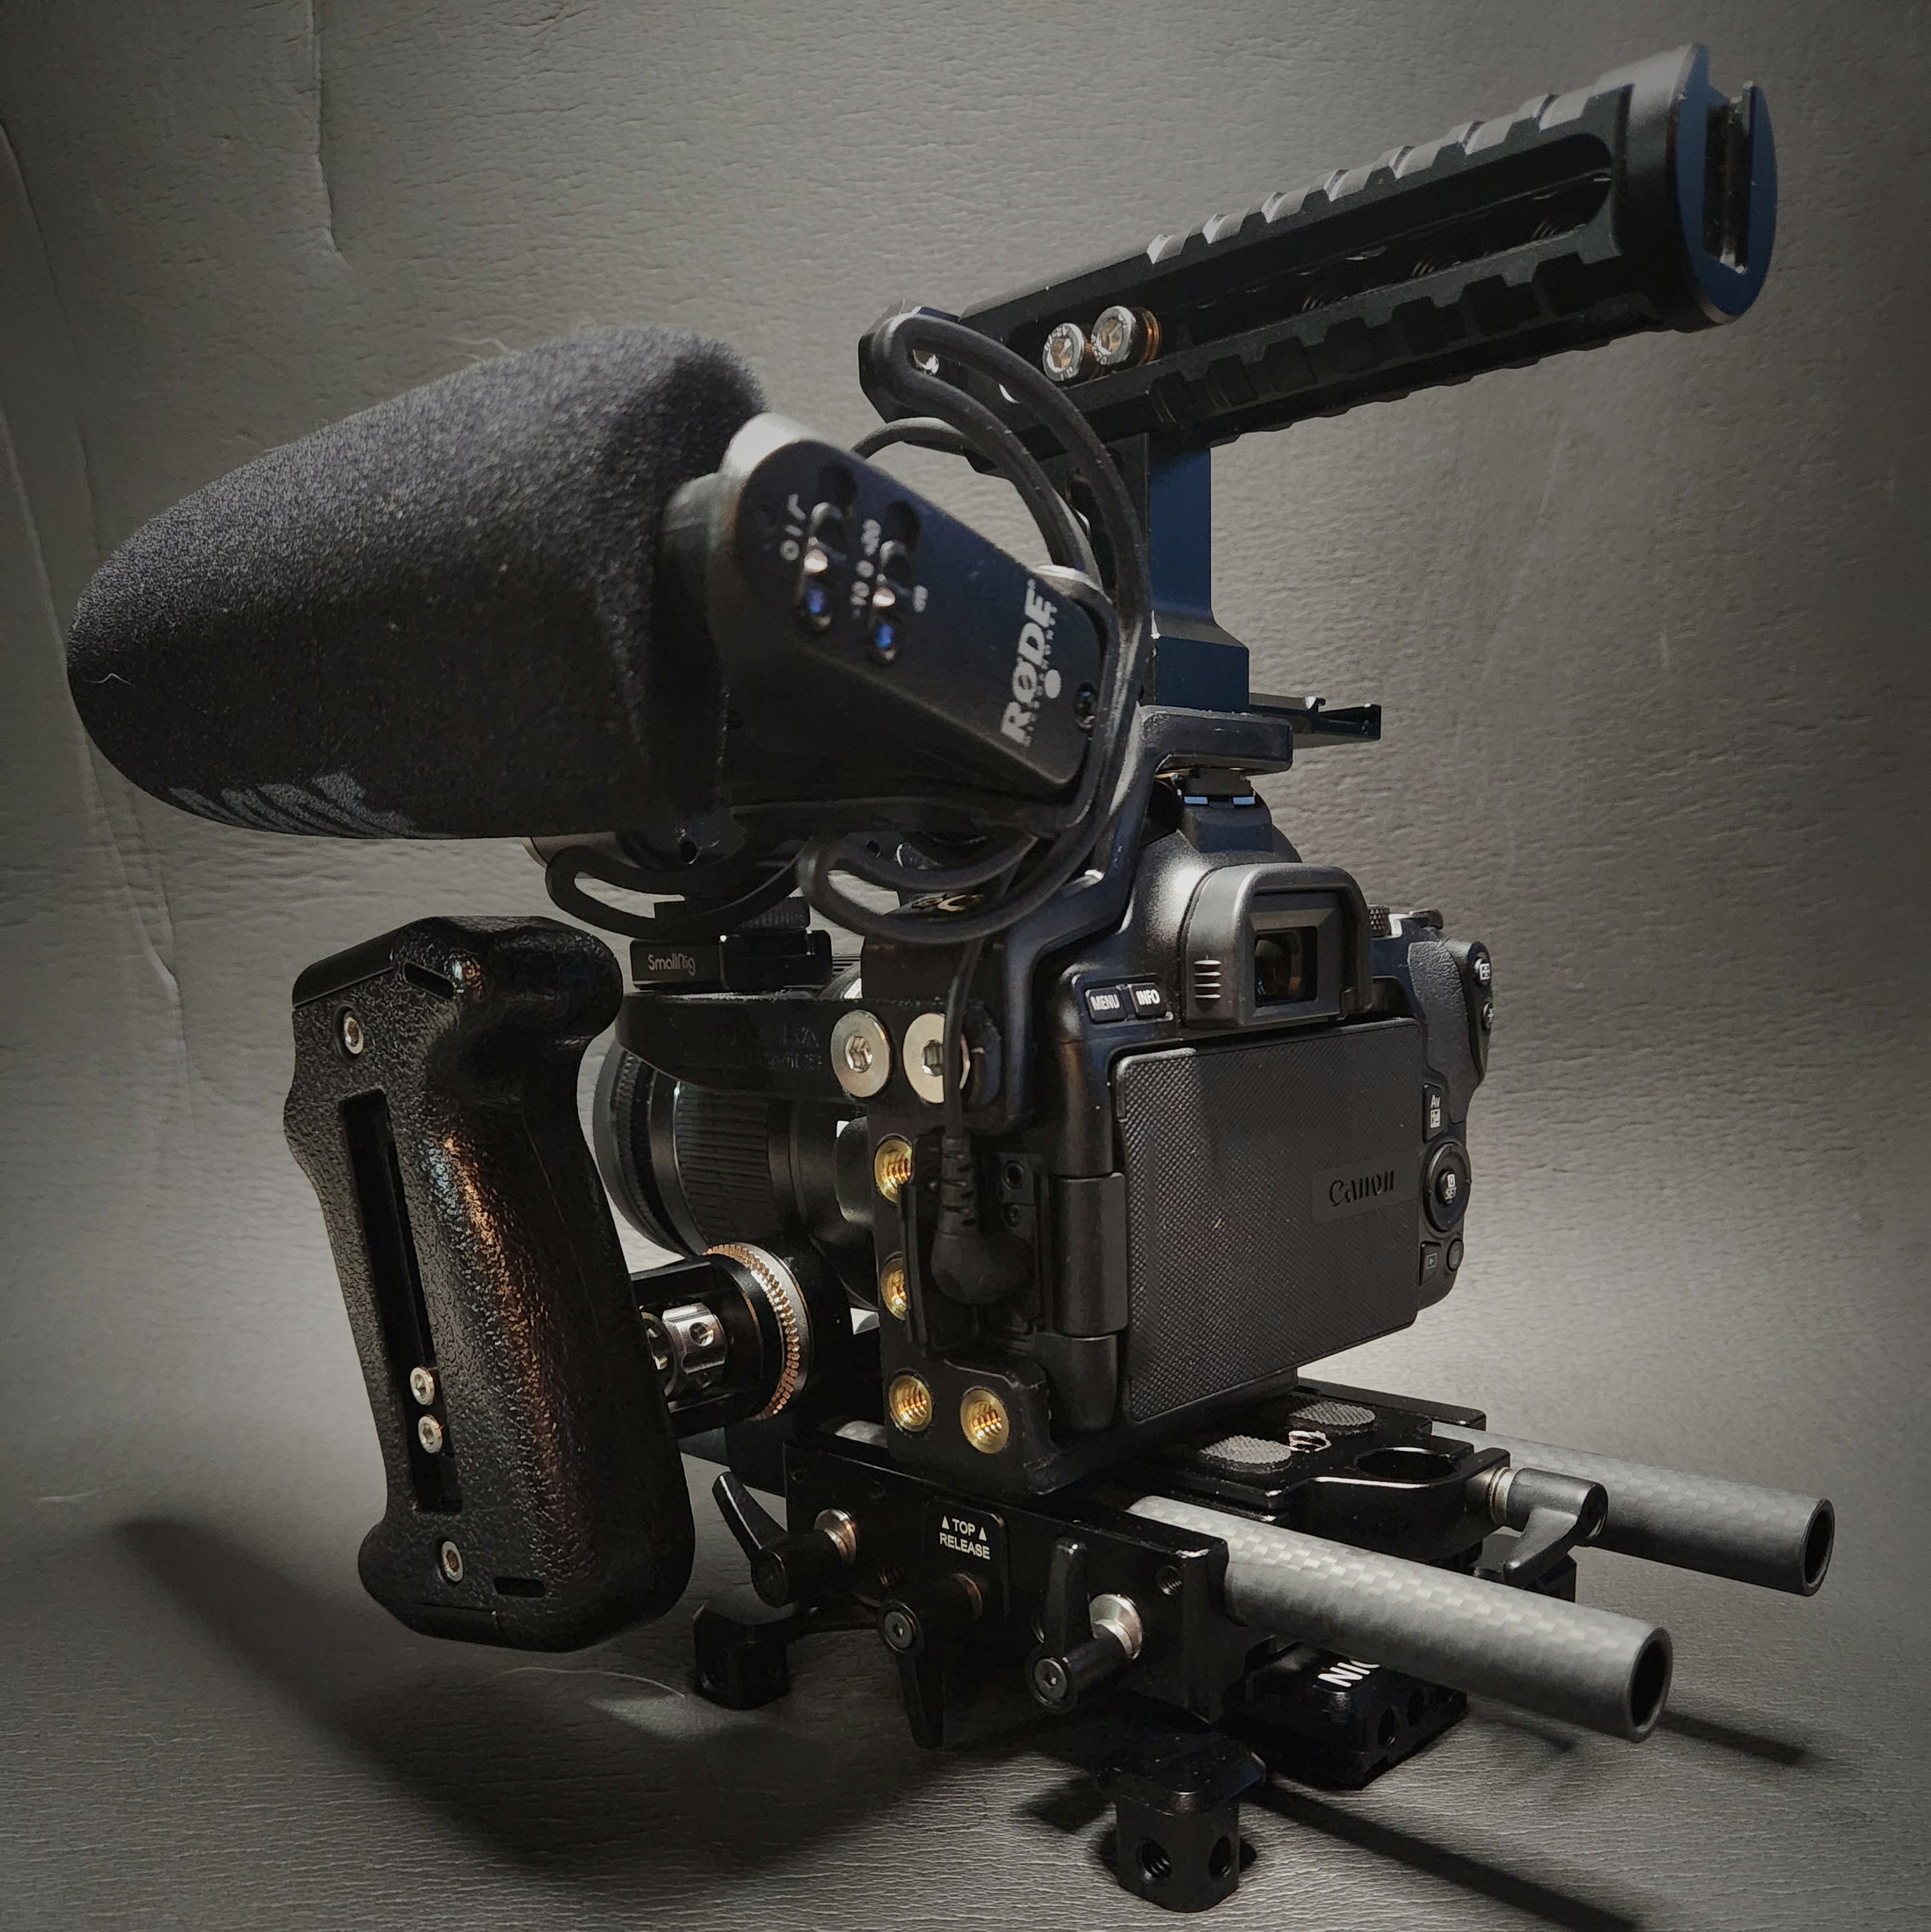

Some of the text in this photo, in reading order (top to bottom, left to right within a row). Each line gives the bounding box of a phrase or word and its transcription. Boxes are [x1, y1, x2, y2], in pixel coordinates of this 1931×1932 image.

[647, 953, 695, 976] SmallRig
[1090, 989, 1160, 1011] MENU INFO
[1431, 1094, 1441, 1108] Av
[1329, 1170, 1395, 1207] Canon
[1445, 1187, 1458, 1200] SET
[952, 1518, 976, 1536] TOP
[939, 1531, 991, 1560] RELEASE
